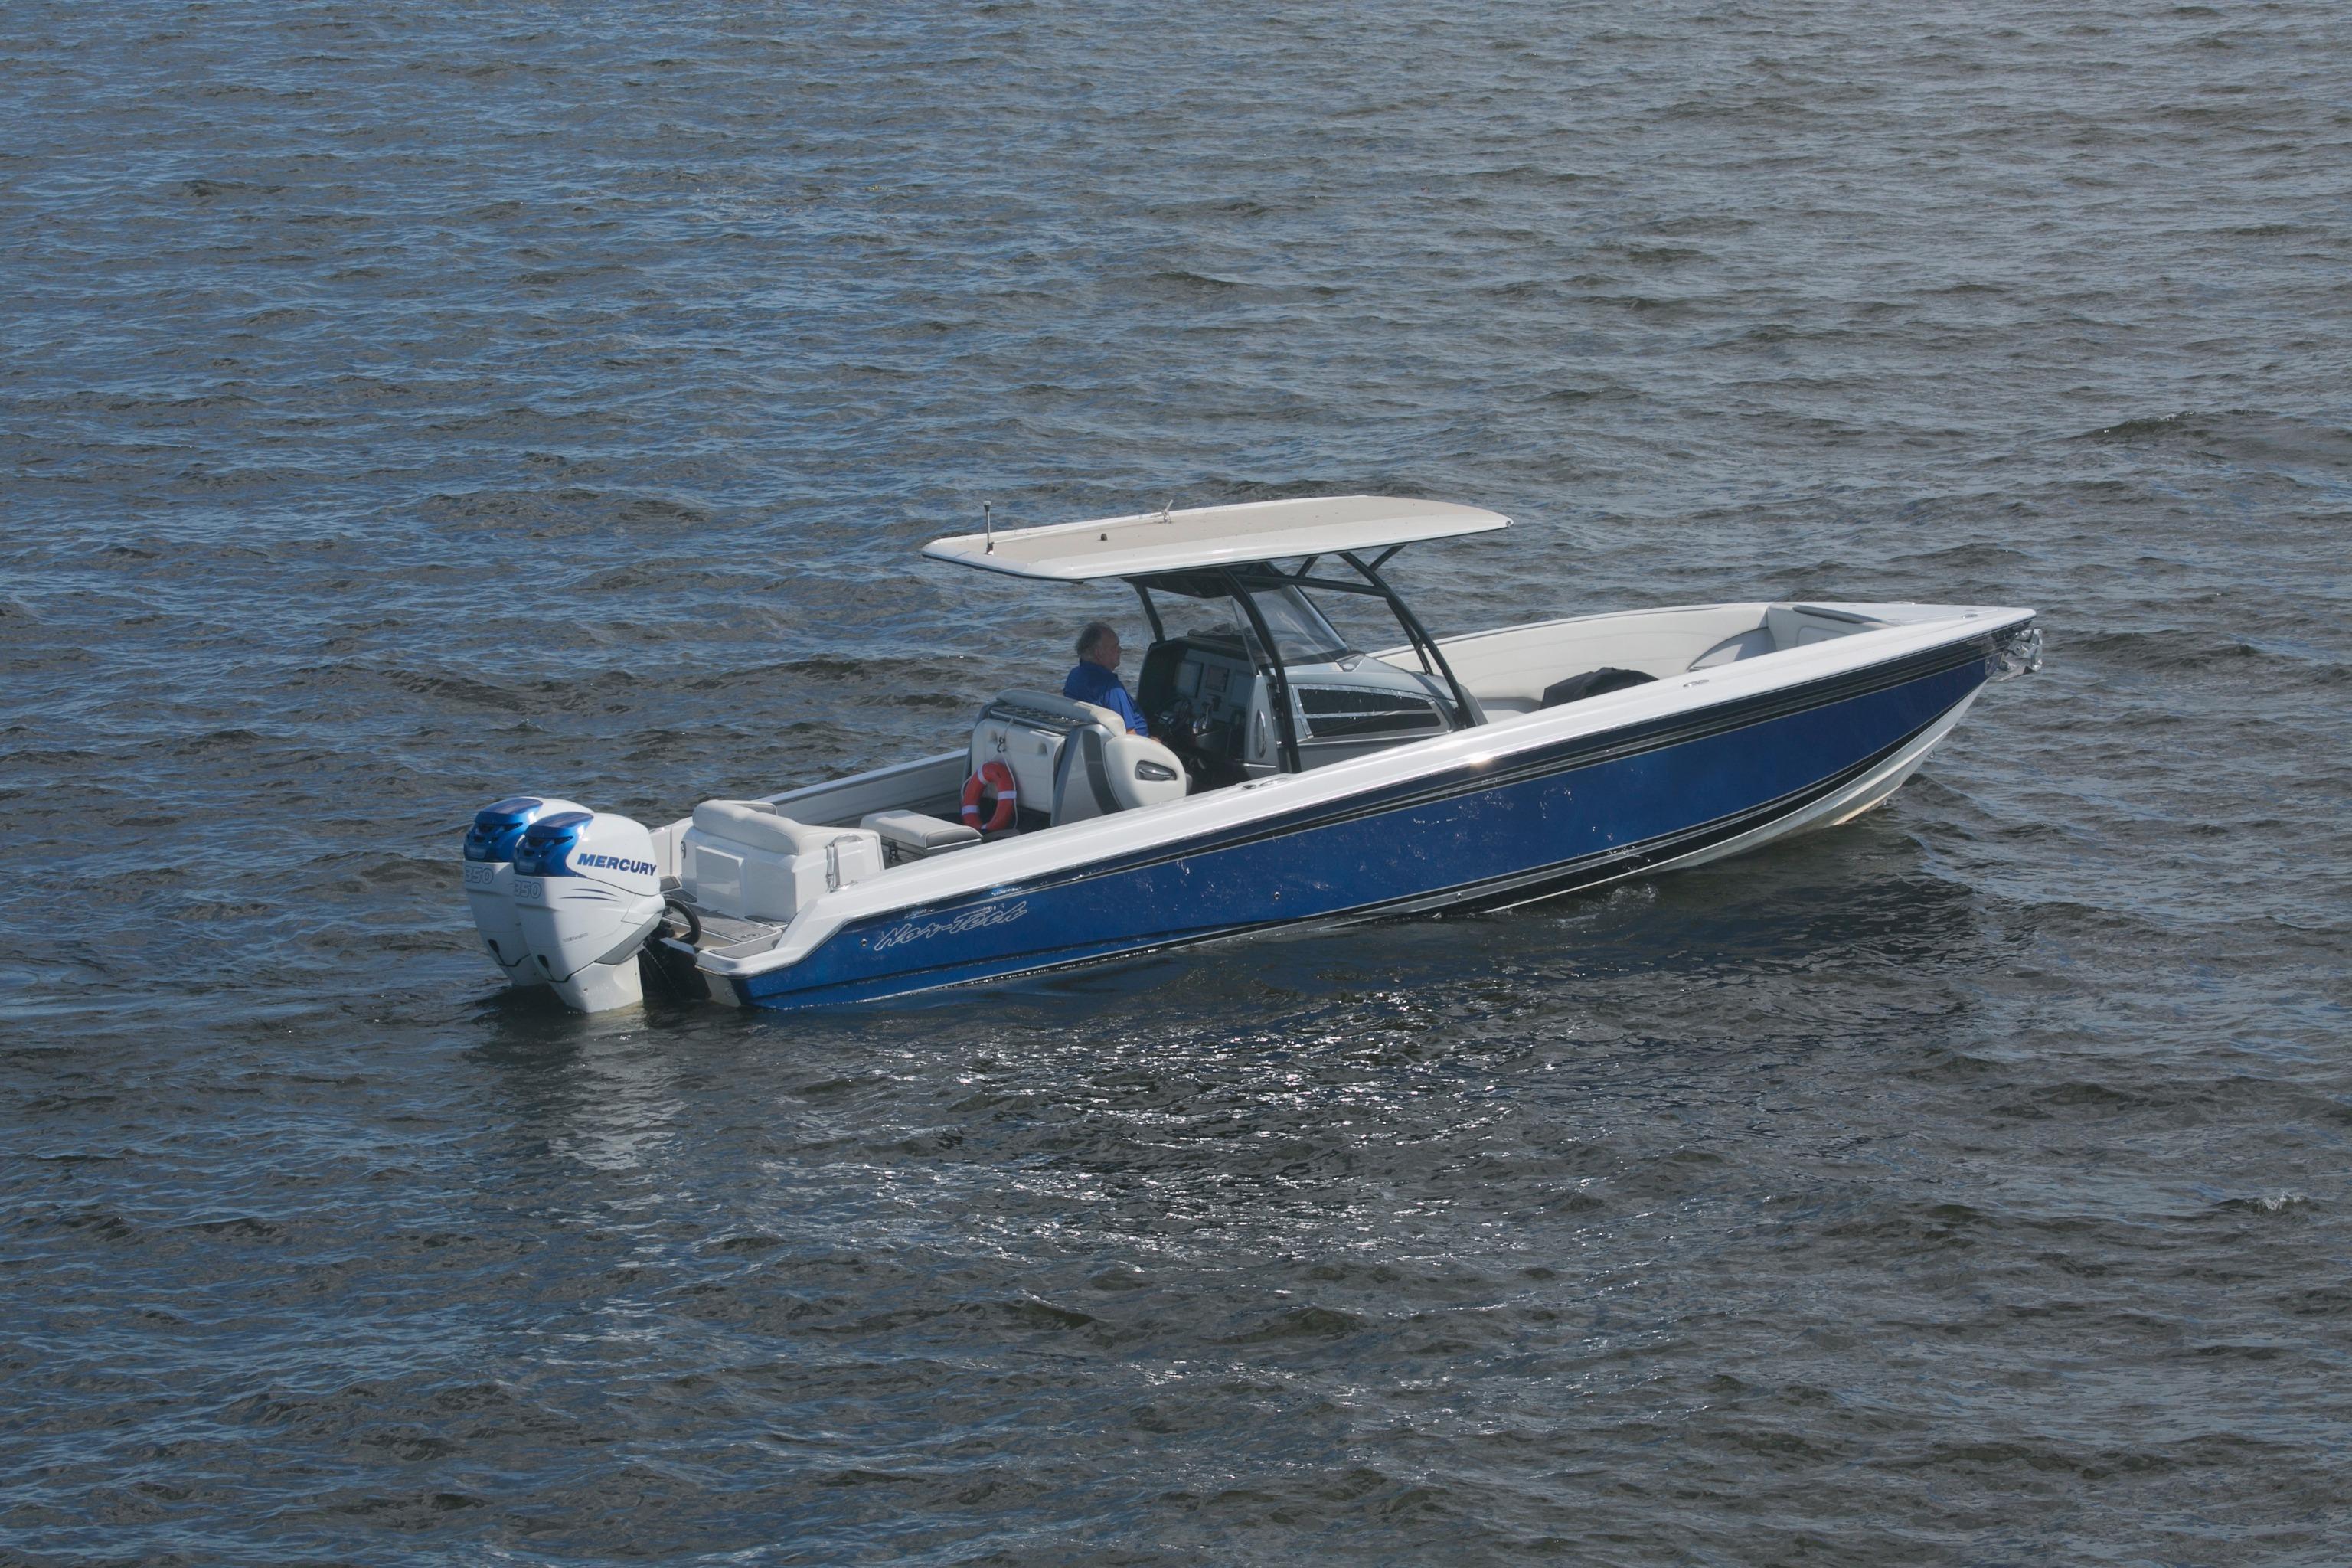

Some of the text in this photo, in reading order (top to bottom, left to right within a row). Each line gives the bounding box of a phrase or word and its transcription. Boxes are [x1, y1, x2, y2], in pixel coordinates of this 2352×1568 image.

[465, 865, 494, 884] 350
[577, 853, 657, 877] MERCURY
[514, 879, 542, 899] 350
